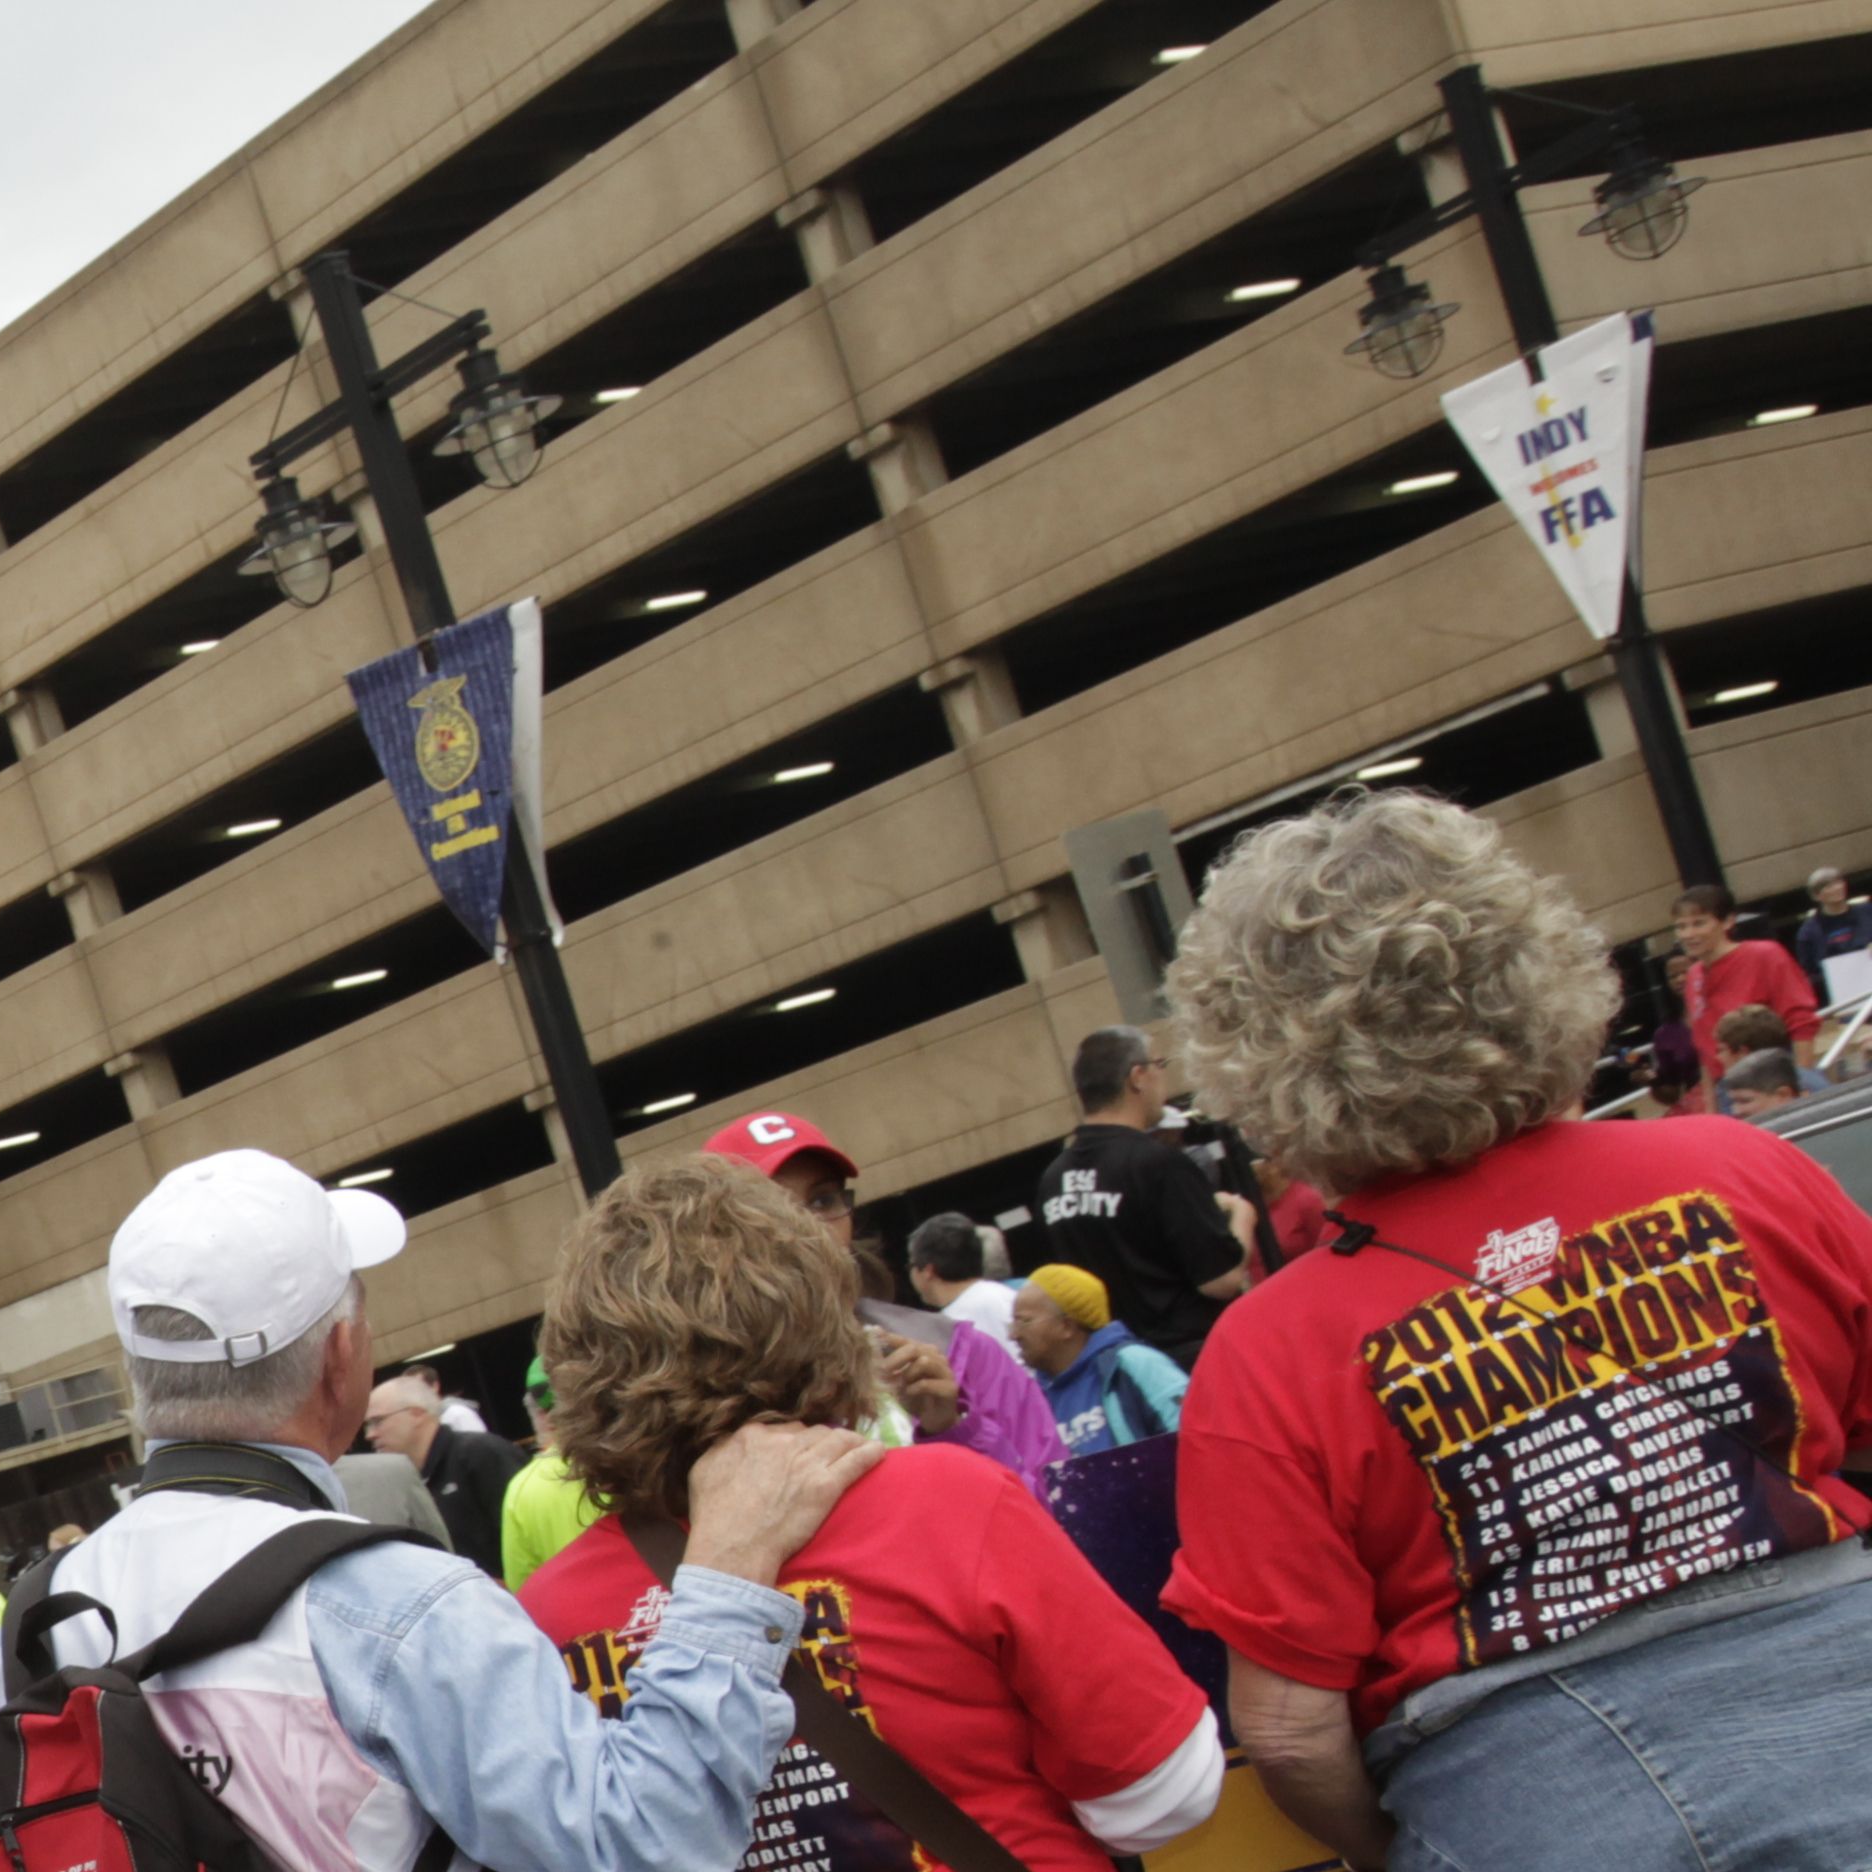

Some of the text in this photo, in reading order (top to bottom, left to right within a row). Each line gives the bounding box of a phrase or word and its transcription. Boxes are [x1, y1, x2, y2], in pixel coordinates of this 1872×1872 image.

[1517, 405, 1589, 467] INDY
[1538, 486, 1618, 546] FFA
[747, 1115, 796, 1145] C
[1553, 1197, 1740, 1308] WNBA
[1380, 1250, 1767, 1458] CHAMPIONS
[1460, 1454, 1493, 1480] 24
[1502, 1414, 1588, 1459] TAMIKA
[1512, 1435, 1603, 1483] KARIMA
[1480, 1446, 1704, 1546] 23 KATIE DOUGLAS
[1518, 1453, 1623, 1507] JESSICA
[1537, 1484, 1740, 1556] BRIANN JANUARY
[1532, 1546, 1629, 1576] ERLANA
[1532, 1575, 1594, 1600] ERIN
[1491, 1610, 1524, 1632] 32
[1538, 1574, 1667, 1622] JEANETTE
[753, 1781, 850, 1818] ENPORT
[736, 1836, 827, 1870] ODLETT
